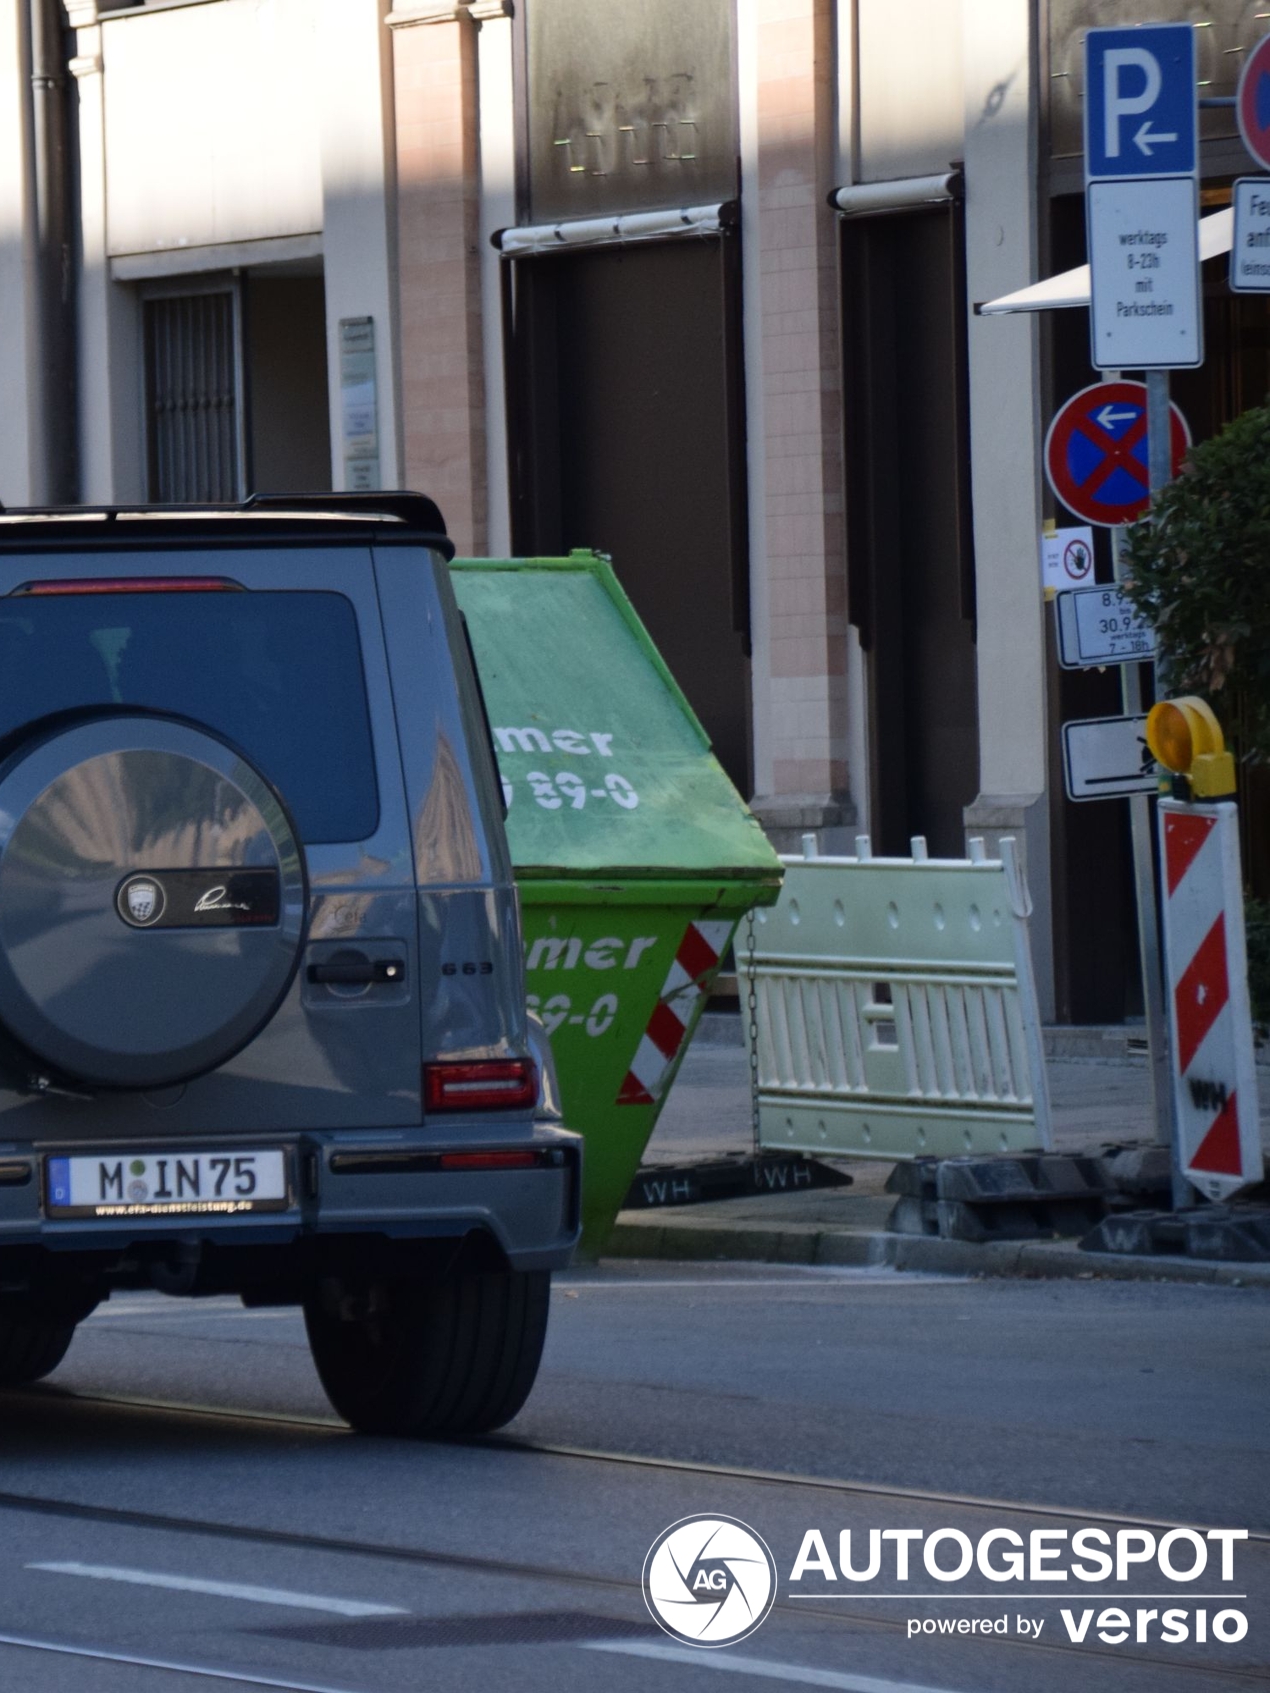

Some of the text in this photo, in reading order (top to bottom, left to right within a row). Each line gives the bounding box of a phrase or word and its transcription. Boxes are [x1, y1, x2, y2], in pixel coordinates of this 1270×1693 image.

[1104, 47, 1161, 158] P
[1250, 194, 1270, 216] Fe
[1119, 230, 1168, 248] werktags
[1127, 252, 1160, 270] 8-23h
[1135, 277, 1154, 293] mit
[1116, 300, 1175, 318] Parkschein
[1110, 631, 1147, 641] werktags
[1108, 643, 1116, 655] 7
[492, 727, 613, 756] mer
[524, 937, 658, 970] mer
[98, 1157, 256, 1200] M IN 75
[764, 1165, 811, 1188] WH
[644, 1180, 690, 1203] WH
[96, 1201, 253, 1216] www.efa-dienstleistung.de
